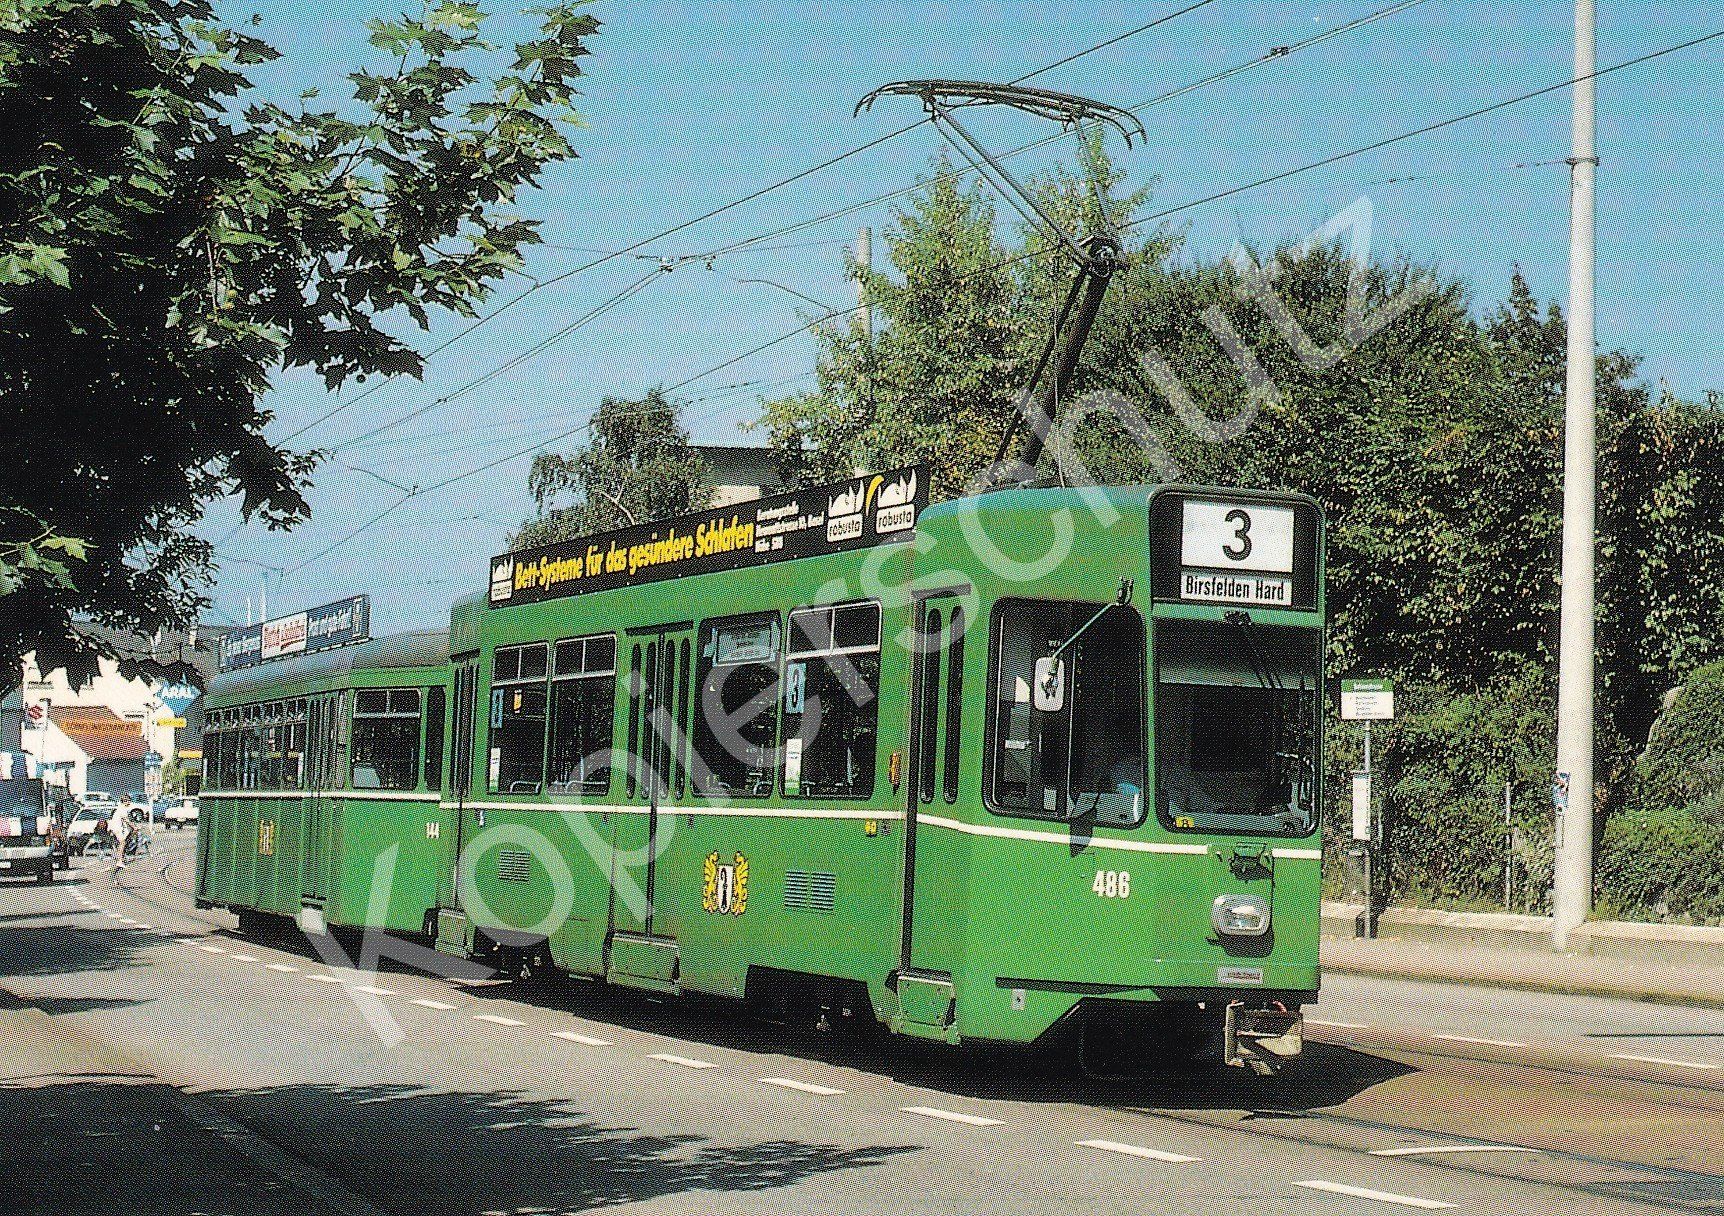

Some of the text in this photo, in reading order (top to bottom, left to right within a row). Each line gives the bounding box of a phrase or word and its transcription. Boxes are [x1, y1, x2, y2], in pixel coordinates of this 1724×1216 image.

[829, 520, 860, 537] robusta
[877, 510, 912, 528] robusta
[1222, 508, 1252, 561] 3
[514, 555, 584, 591] Bett-Systeme
[585, 544, 605, 577] für
[605, 540, 627, 574] das
[628, 528, 694, 576] gesündere
[695, 514, 755, 558] Schlafen
[1185, 576, 1285, 601] Birsfelden Hard
[161, 685, 195, 700] ARAL
[791, 668, 799, 709] 3
[426, 821, 440, 839] 144
[1092, 870, 1130, 898] 486
